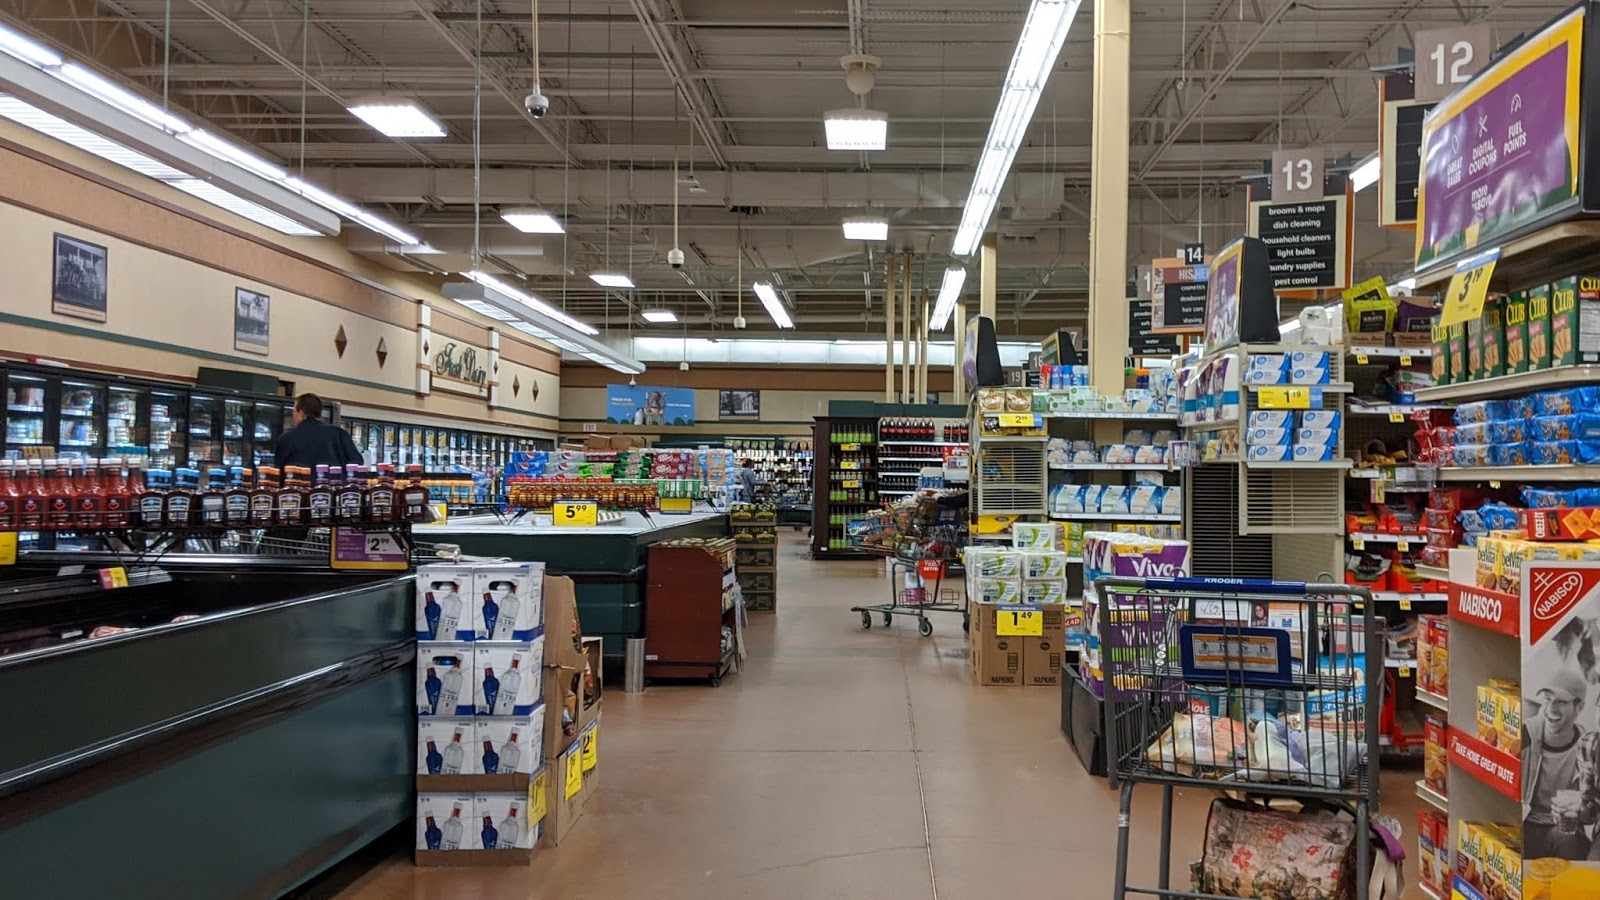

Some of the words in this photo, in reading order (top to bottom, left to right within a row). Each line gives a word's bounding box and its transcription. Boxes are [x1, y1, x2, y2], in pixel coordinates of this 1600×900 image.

[1431, 41, 1473, 85] 12
[1508, 120, 1523, 139] FUEL
[1472, 138, 1494, 160] DIGITAL
[1503, 132, 1527, 156] POINTS
[1468, 150, 1497, 175] COUPONS
[1282, 159, 1313, 191] 13
[1269, 207, 1296, 215] brooms
[1305, 205, 1325, 214] mops
[1273, 221, 1288, 229] dish
[1290, 219, 1321, 228] cleaning
[1301, 234, 1331, 243] cleaners
[1187, 247, 1203, 262] 14
[1277, 249, 1294, 258] light
[1295, 248, 1316, 256] bulbs
[1295, 262, 1326, 271] supplies
[1274, 278, 1290, 286] pest
[1291, 276, 1318, 284] control
[1580, 277, 1600, 291] CLU
[1529, 297, 1548, 321] CLUB
[1553, 290, 1574, 314] CLUB
[1506, 303, 1525, 326] CLUB
[1431, 325, 1447, 344] CLUB
[1011, 371, 1021, 382] 19
[1537, 575, 1579, 616] NABISCO
[1459, 591, 1502, 623] NABISCO
[1455, 742, 1467, 757] TAKE
[1466, 748, 1480, 765] HOME
[1480, 756, 1498, 774] GREAT
[1497, 765, 1515, 784] TASTE
